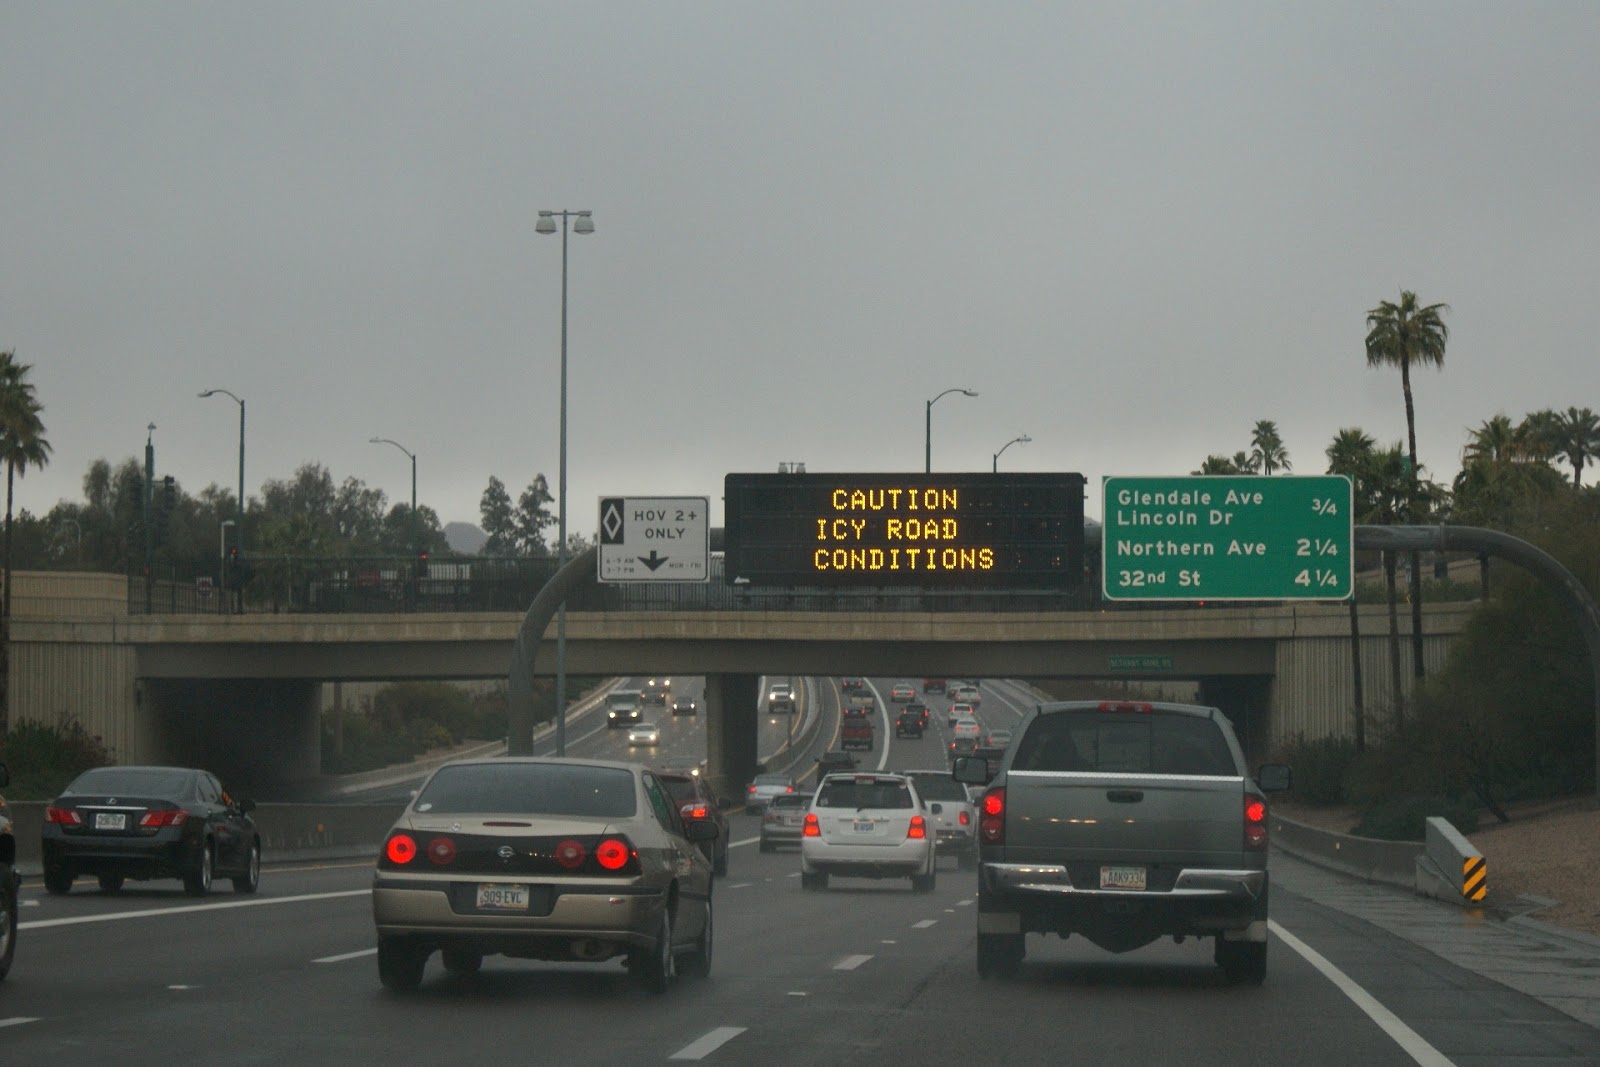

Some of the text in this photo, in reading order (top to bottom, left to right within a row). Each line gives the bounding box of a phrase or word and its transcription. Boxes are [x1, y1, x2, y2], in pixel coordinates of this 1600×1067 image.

[832, 489, 957, 510] CAUTION
[1118, 489, 1264, 505] Glendale Ave
[634, 510, 666, 521] HOV
[1117, 510, 1233, 526] Lincoln Dr
[645, 528, 685, 539] ONLY
[817, 519, 957, 540] ICY ROAD
[1117, 540, 1214, 556] Northern
[1227, 540, 1266, 556] Ave
[814, 548, 994, 570] CONDITIONS
[1119, 570, 1166, 587] 32nd
[1178, 570, 1201, 587] St
